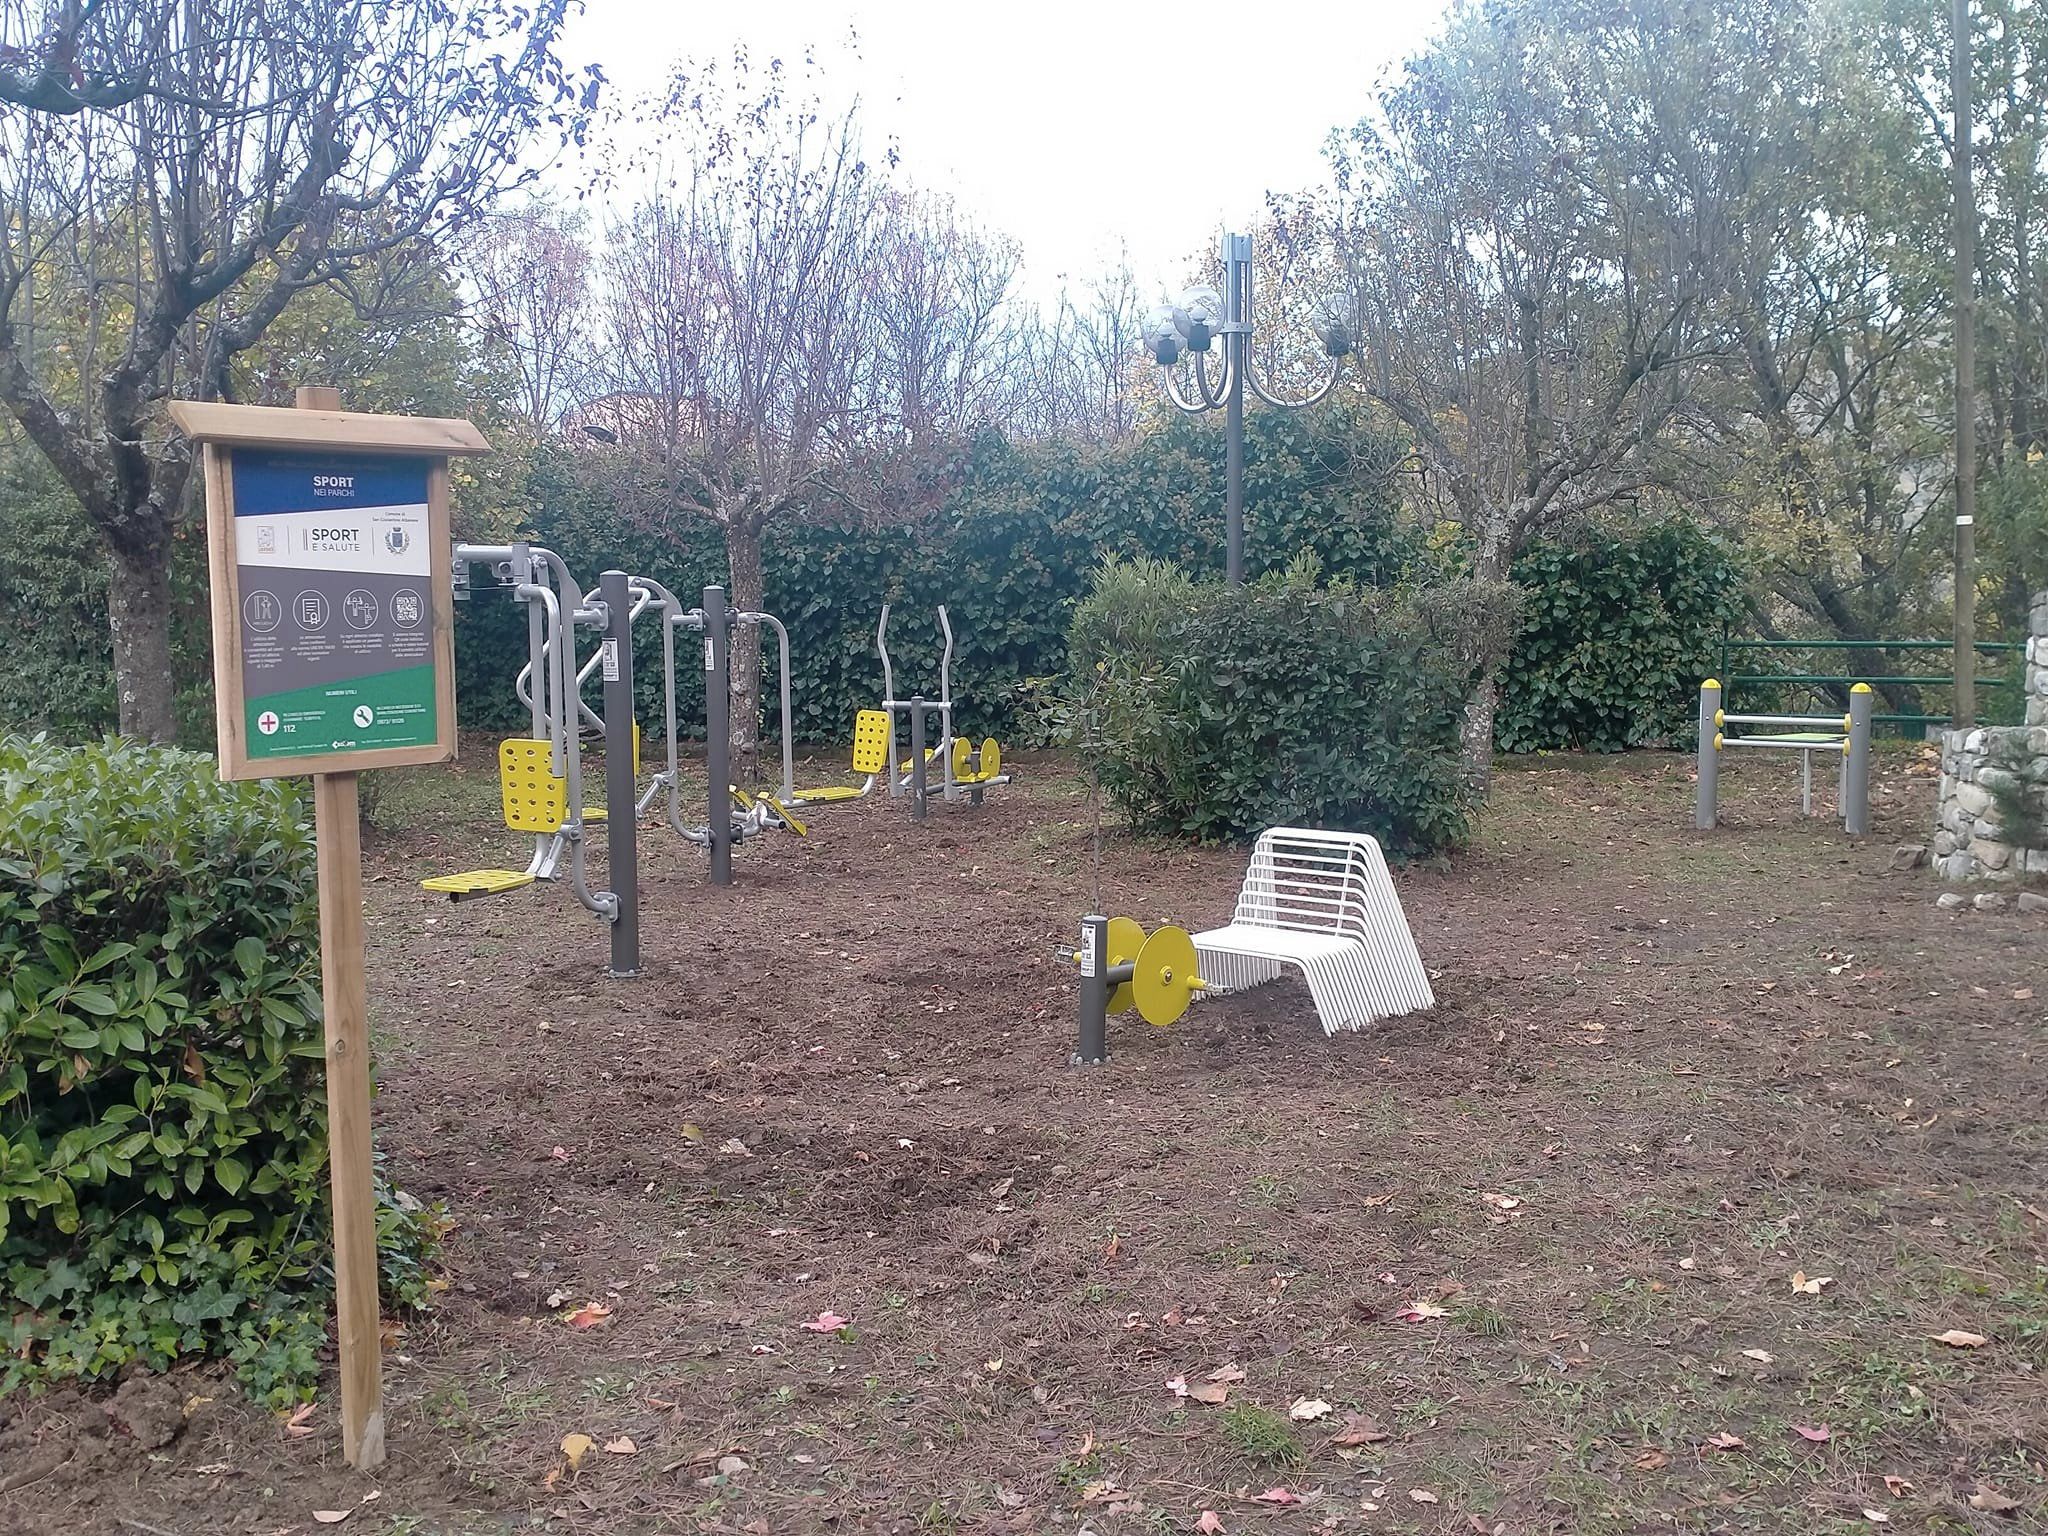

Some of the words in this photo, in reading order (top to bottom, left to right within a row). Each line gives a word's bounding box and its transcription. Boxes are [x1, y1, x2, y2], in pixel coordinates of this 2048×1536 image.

[313, 475, 354, 487] SPORT
[313, 488, 327, 496] NEI
[328, 488, 355, 497] PARCHI
[312, 528, 360, 541] SPORT
[312, 543, 318, 552] E
[322, 543, 360, 552] SALUTE
[283, 724, 297, 733] 112
